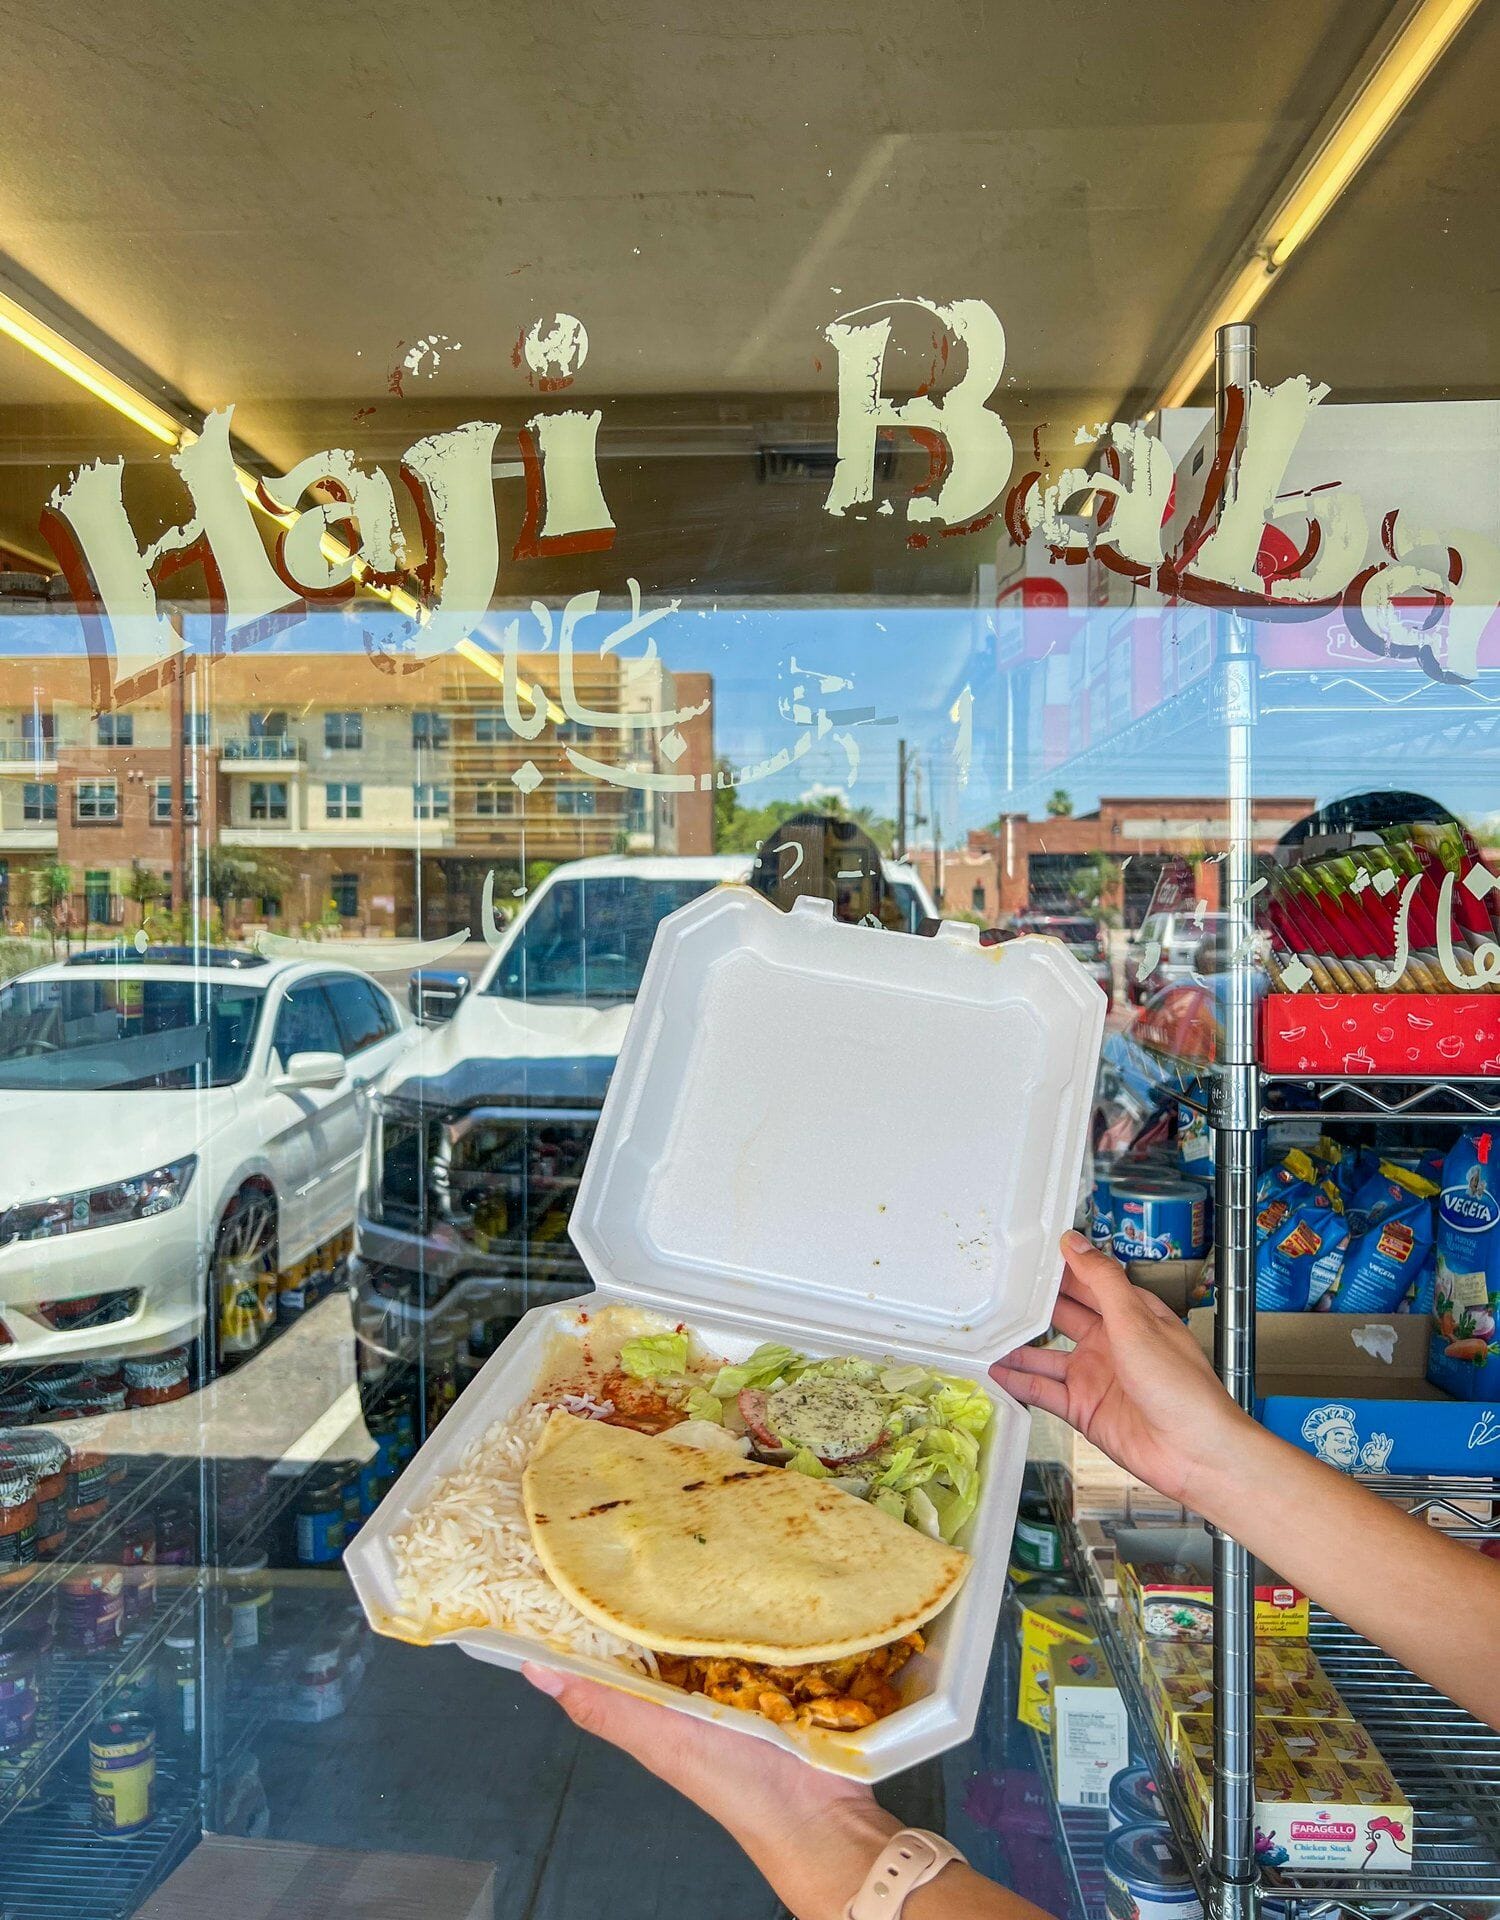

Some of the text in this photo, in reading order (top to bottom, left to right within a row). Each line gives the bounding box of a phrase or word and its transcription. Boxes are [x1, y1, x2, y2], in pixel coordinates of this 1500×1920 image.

[820, 297, 1500, 685] Baba
[1445, 1194, 1491, 1222] VEGETA
[1113, 1240, 1163, 1260] VEGETA
[1369, 1262, 1396, 1281] VEGETA
[1292, 1824, 1354, 1834] FARAGELLO
[1294, 1843, 1353, 1852] Chicken Stock
